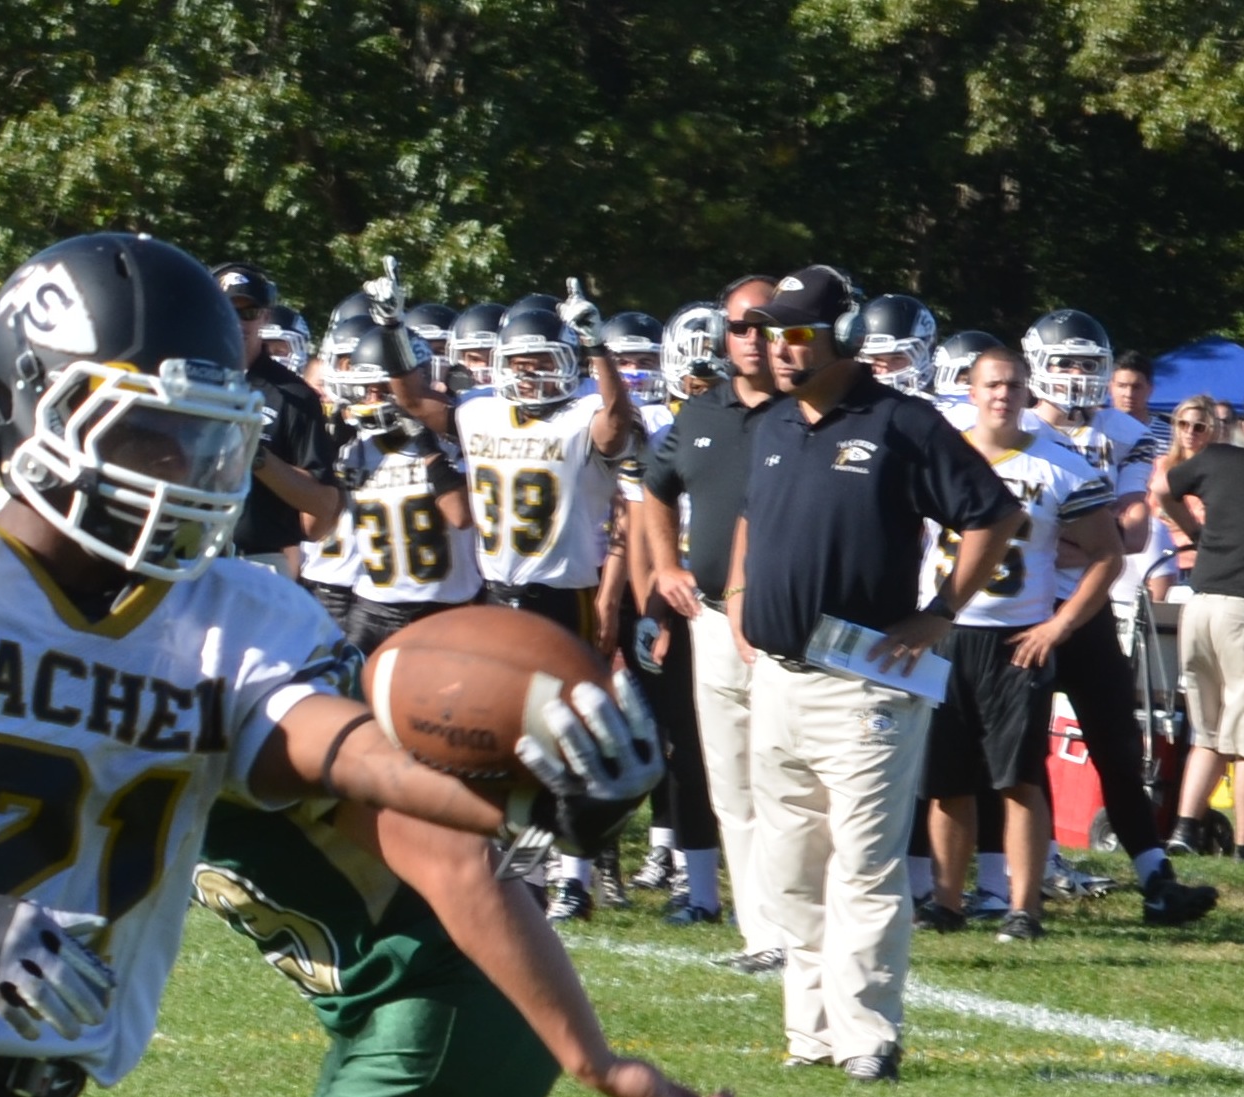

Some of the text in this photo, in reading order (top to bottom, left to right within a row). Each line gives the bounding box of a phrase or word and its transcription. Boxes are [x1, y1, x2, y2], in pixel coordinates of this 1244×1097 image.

[468, 432, 565, 462] SACHEM
[356, 494, 453, 588] 38
[473, 464, 562, 558] 39
